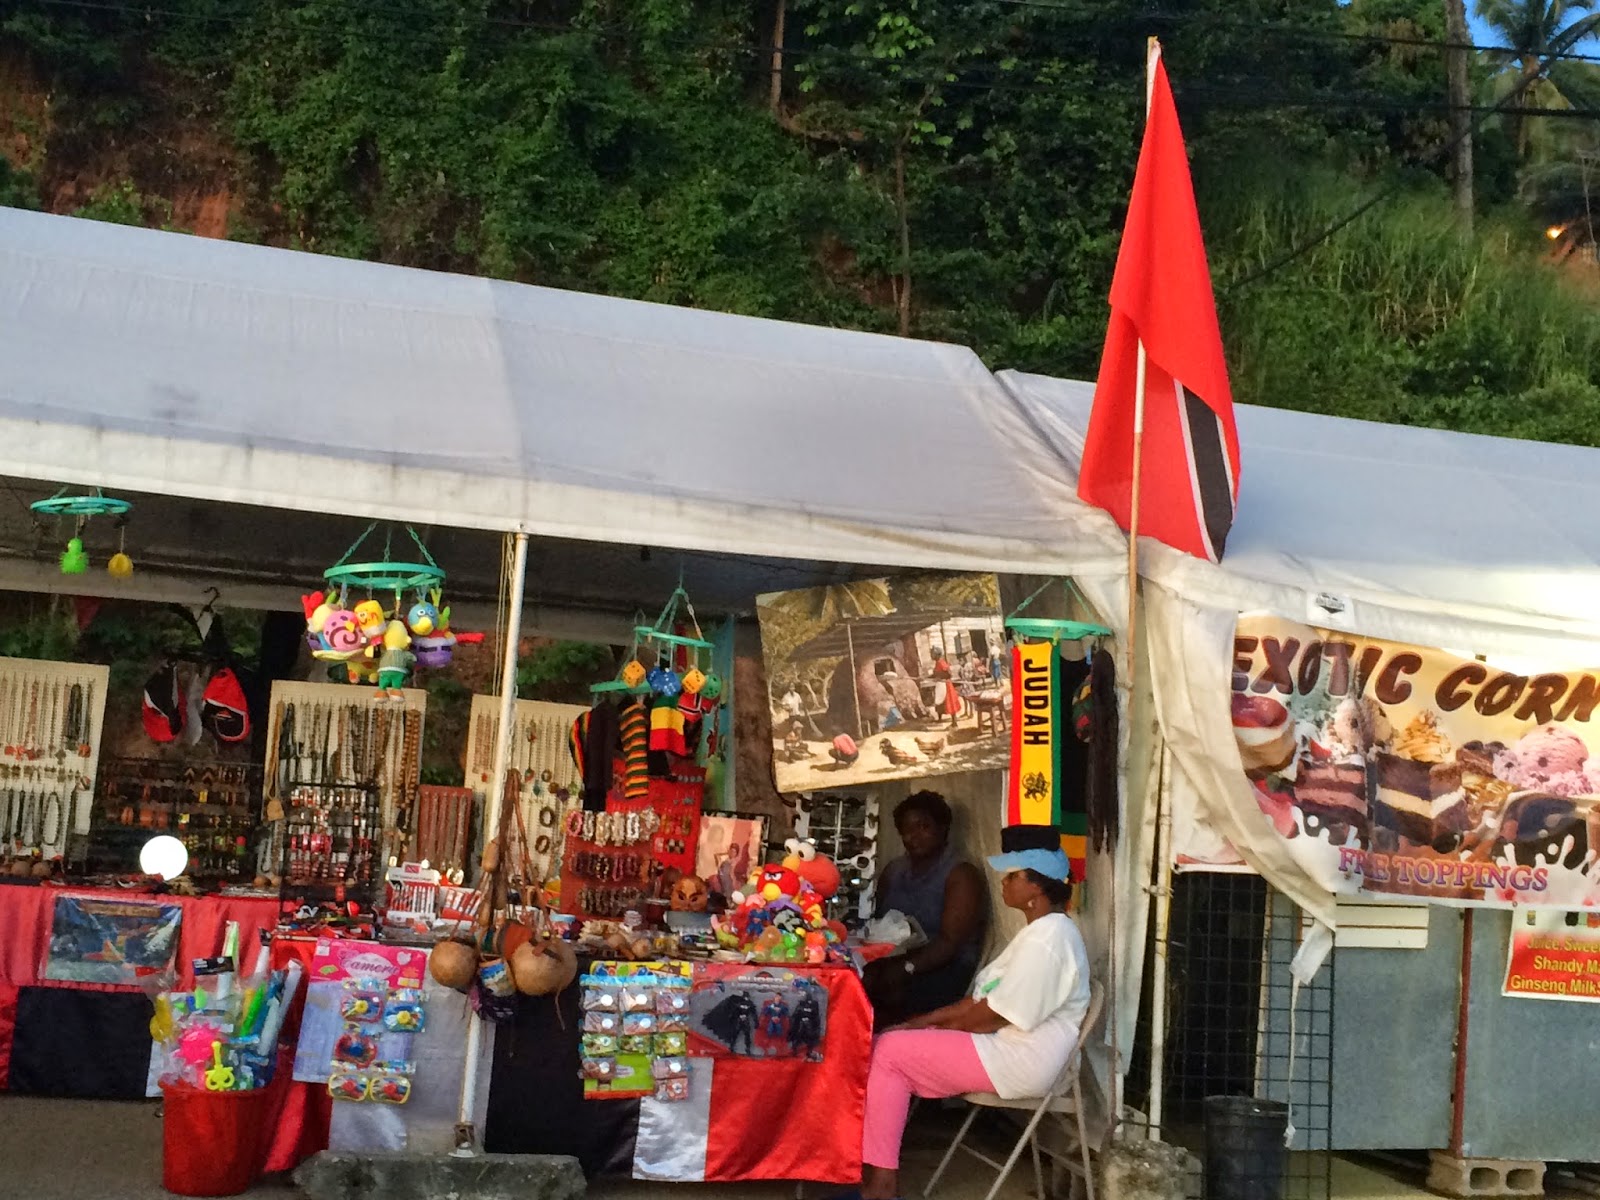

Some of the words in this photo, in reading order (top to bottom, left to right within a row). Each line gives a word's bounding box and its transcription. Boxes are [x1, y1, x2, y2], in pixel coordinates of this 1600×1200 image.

[1023, 658, 1050, 745] JUDAH
[1231, 635, 1423, 704] EXOTIC
[1393, 857, 1549, 891] TOPPINGS
